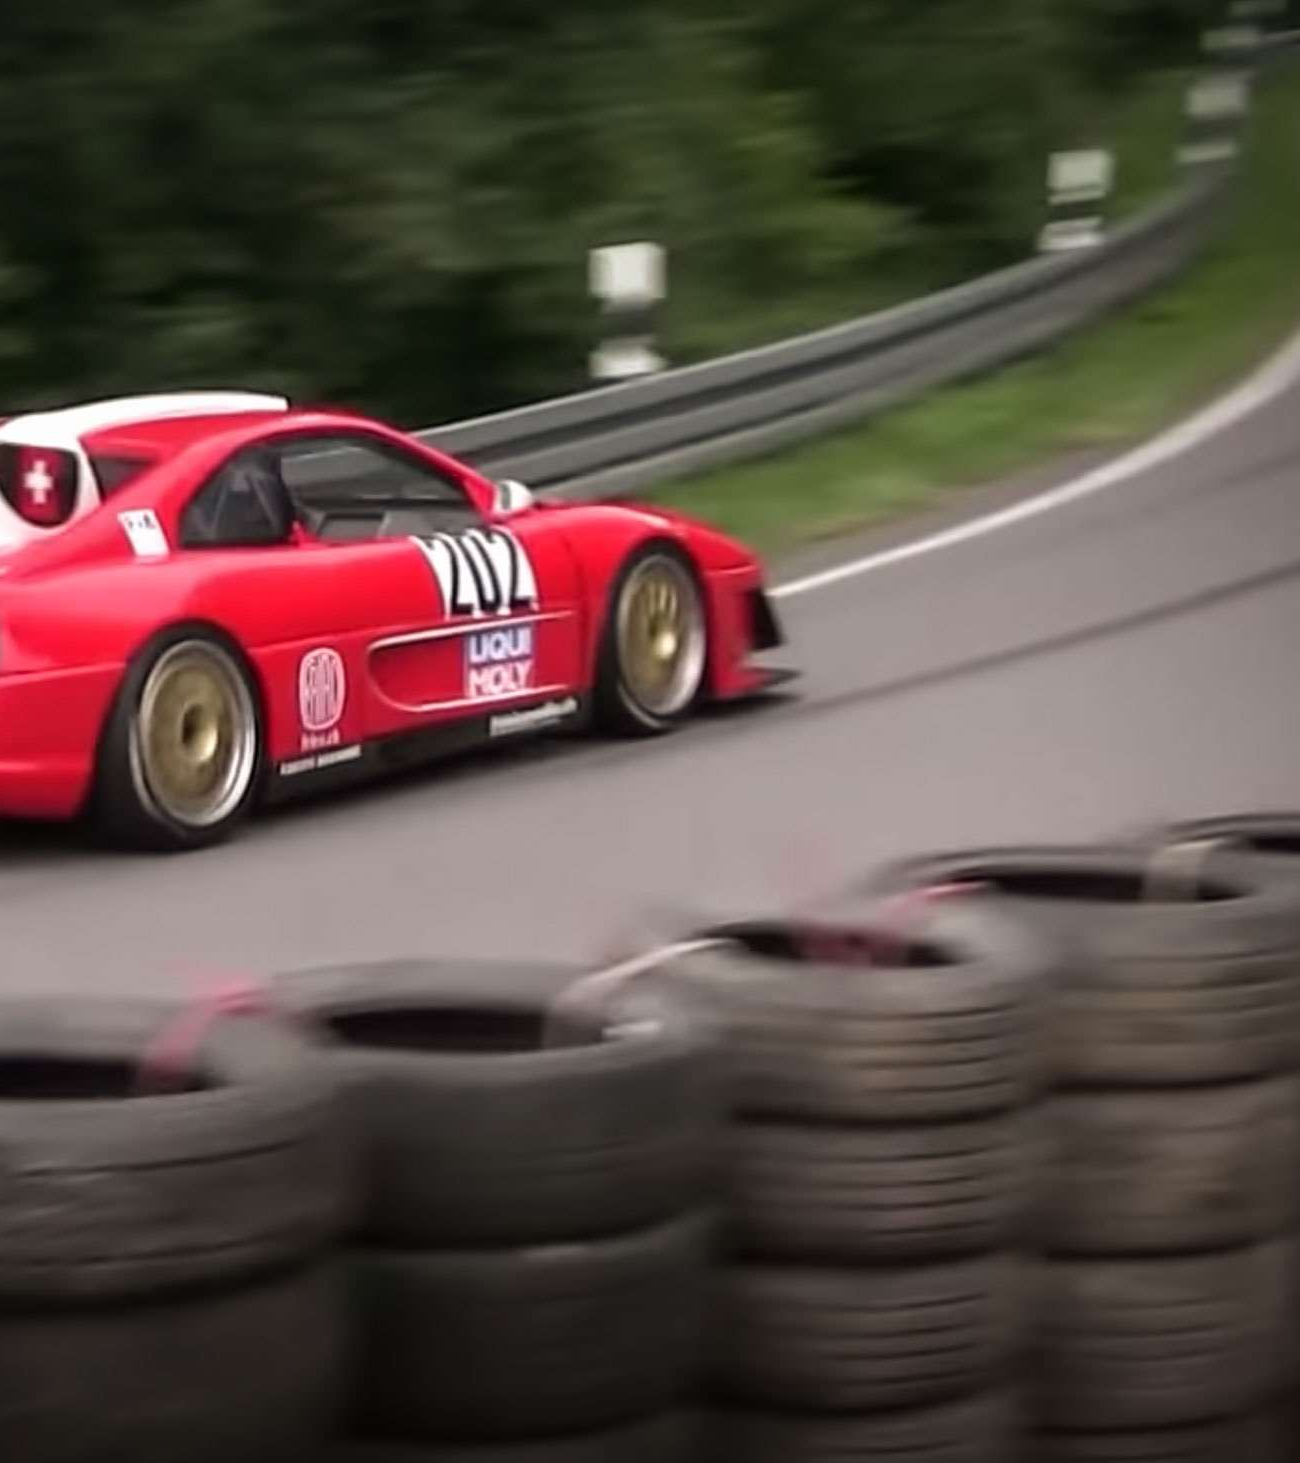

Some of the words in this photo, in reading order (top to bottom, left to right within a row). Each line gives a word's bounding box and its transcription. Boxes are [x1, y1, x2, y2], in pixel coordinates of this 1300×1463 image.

[427, 529, 532, 615] 202
[469, 627, 532, 663] LIQUI
[466, 660, 534, 698] MOLY
